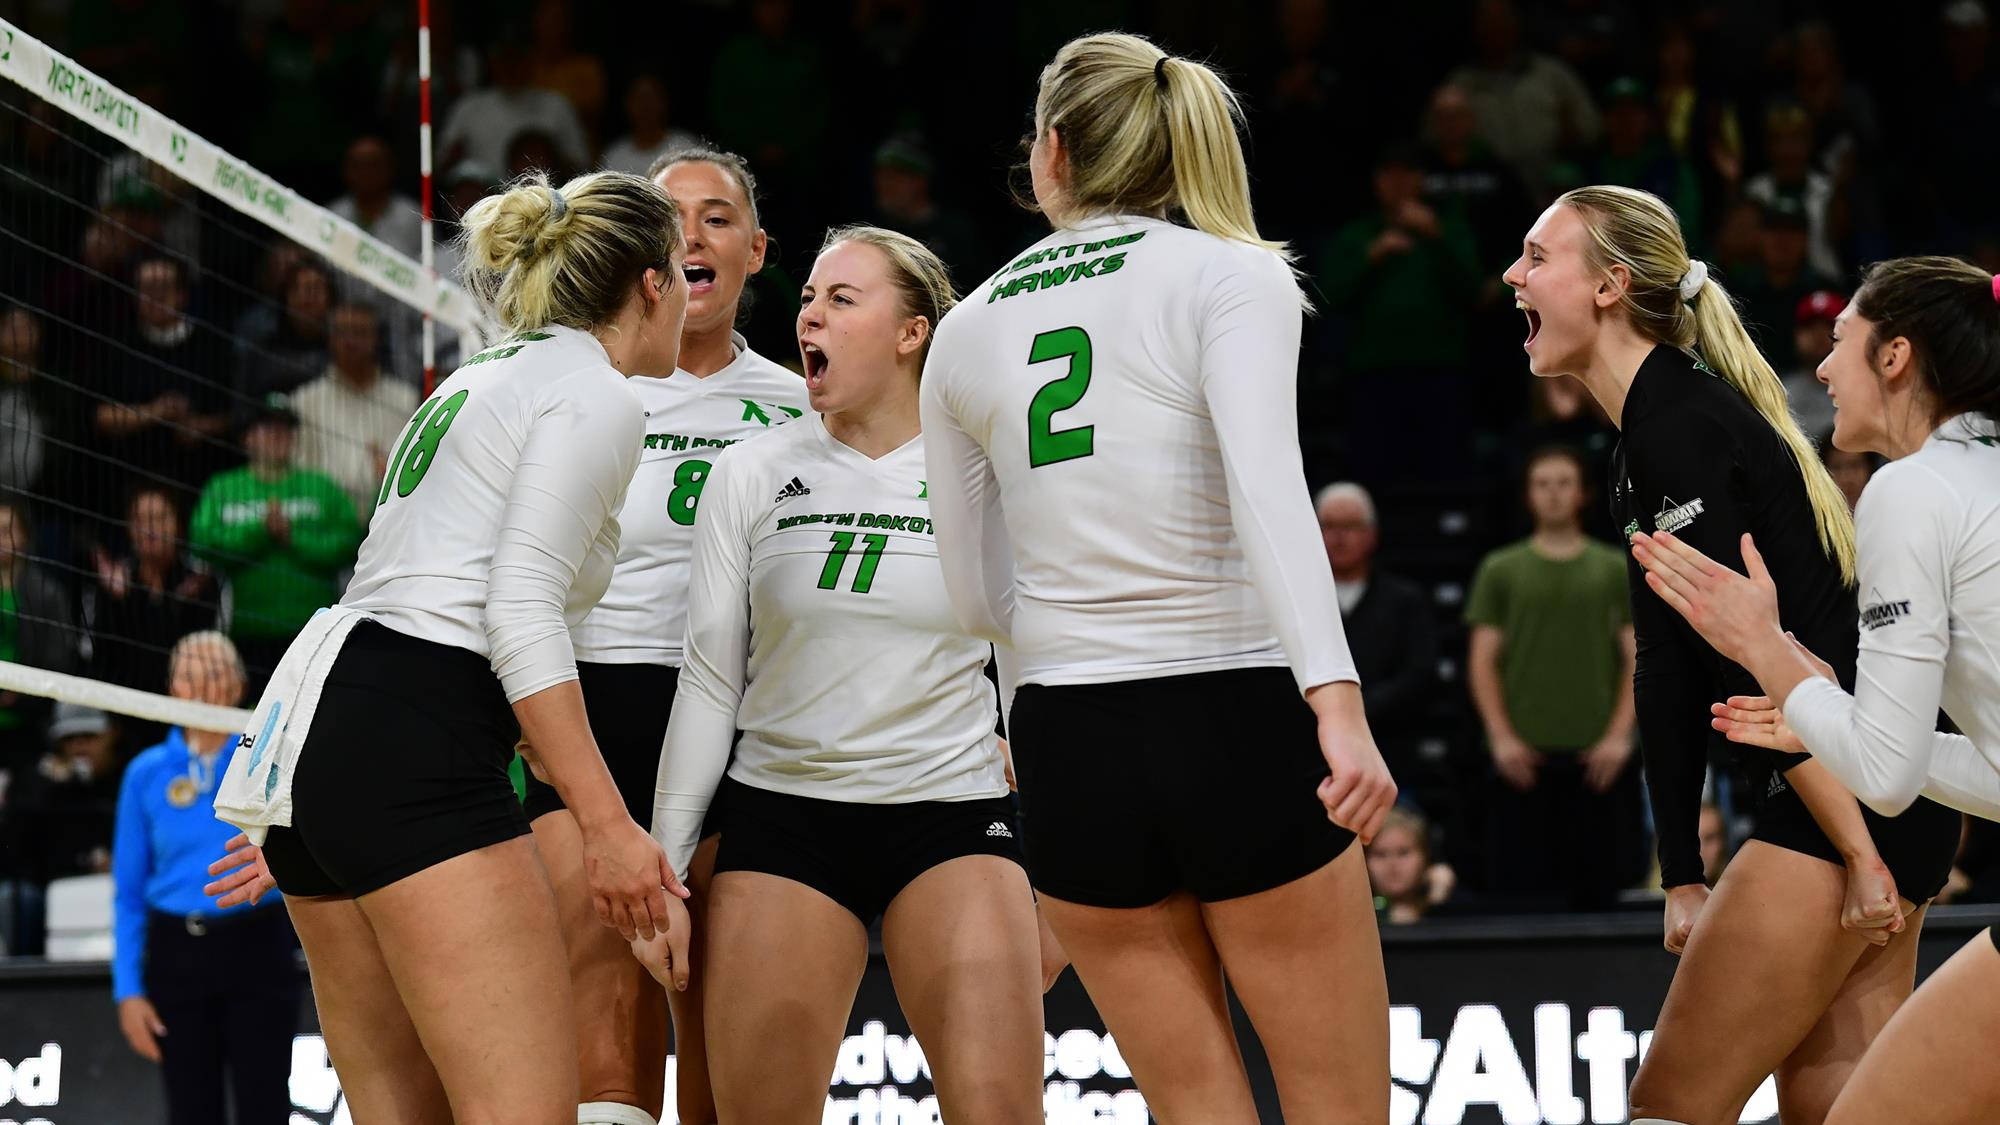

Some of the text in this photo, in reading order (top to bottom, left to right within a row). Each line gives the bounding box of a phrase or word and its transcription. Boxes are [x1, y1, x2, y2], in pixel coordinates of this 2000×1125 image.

[987, 252, 1128, 305] HAWKS
[1028, 326, 1094, 468] 2
[378, 389, 469, 506] 18
[643, 434, 688, 451] RTH
[667, 459, 713, 526] 8
[1655, 497, 1705, 531] SUMMIT
[777, 513, 934, 535] NORTH DAKOT
[817, 531, 888, 593] 11
[986, 829, 1013, 838] adidas
